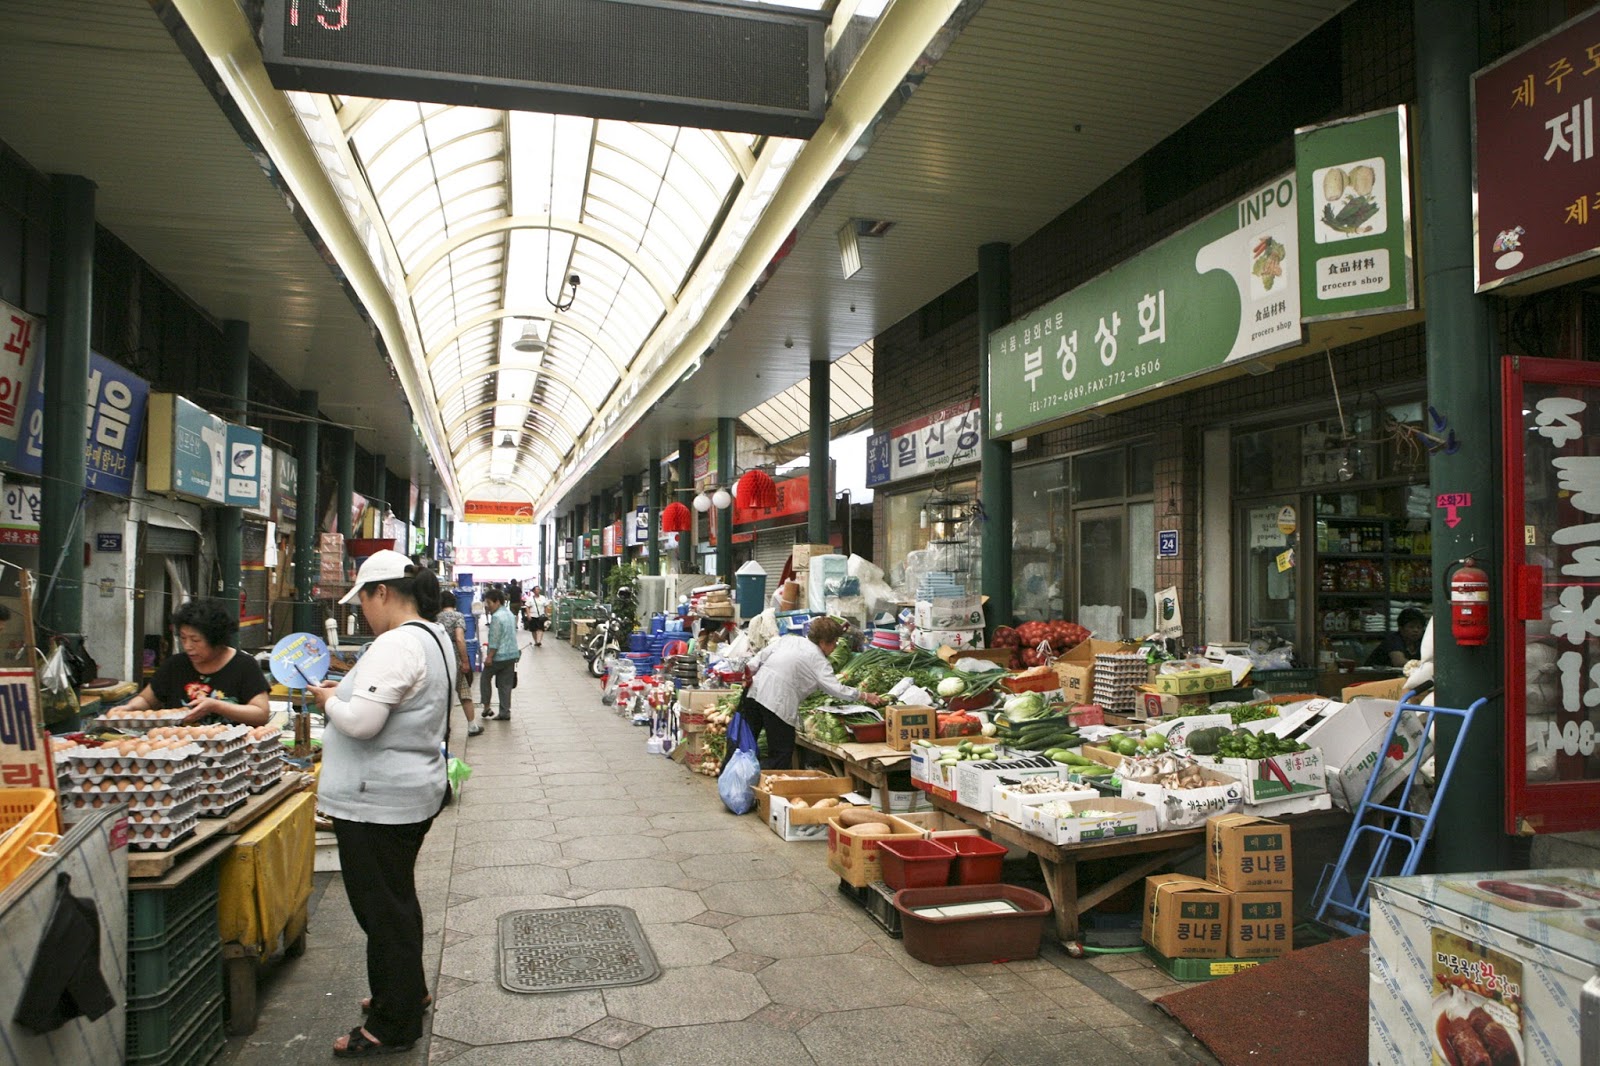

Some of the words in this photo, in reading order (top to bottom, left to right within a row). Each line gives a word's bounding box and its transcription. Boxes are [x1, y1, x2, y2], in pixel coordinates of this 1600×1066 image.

[1240, 180, 1292, 228] INPO
[1328, 257, 1375, 275] 食品材料
[1322, 279, 1357, 292] grocers
[1361, 276, 1384, 286] shop
[1255, 300, 1286, 322] 食品材料
[1251, 326, 1274, 341] grocers
[1277, 320, 1292, 332] shop
[1024, 289, 1166, 392] 부성상회
[1440, 494, 1467, 506] 소화기
[101, 539, 117, 548] 25
[1162, 539, 1174, 549] 24
[1240, 855, 1286, 874] 콩나물
[1177, 923, 1222, 941] 콩나물
[1240, 924, 1286, 942] 콩나물
[1401, 941, 1418, 969] STEEL
[1370, 952, 1398, 1000] STAINLESS
[1400, 1006, 1418, 1034] STEEL
[1370, 1016, 1400, 1066] STAINLESS
